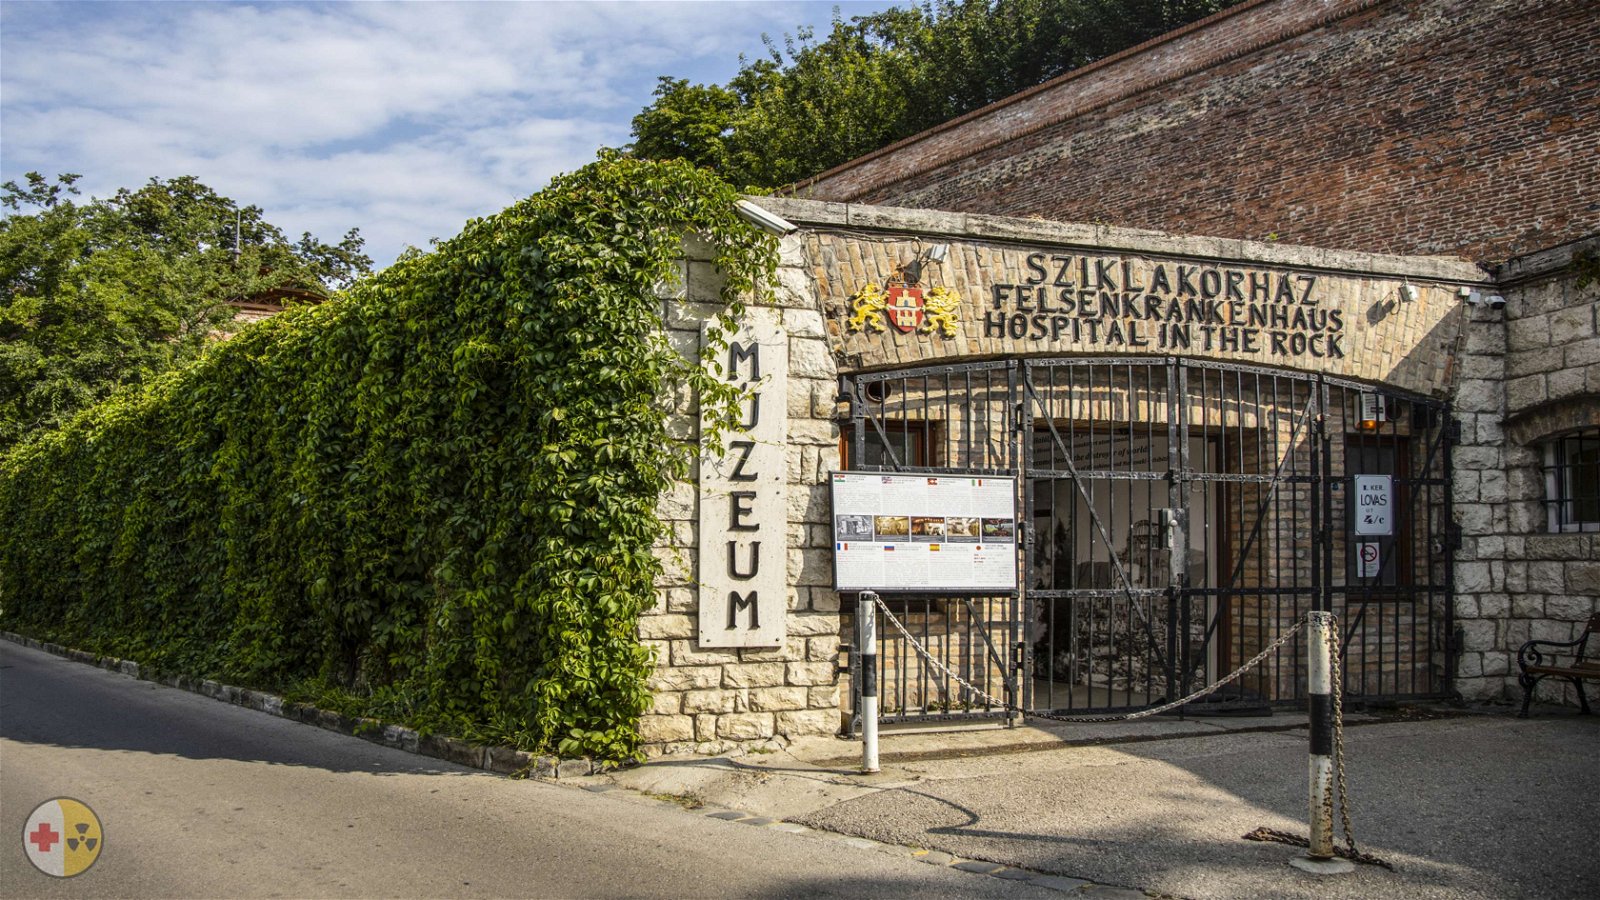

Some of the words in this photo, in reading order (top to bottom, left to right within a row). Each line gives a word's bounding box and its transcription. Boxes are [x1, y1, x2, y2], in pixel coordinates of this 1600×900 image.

[991, 283, 1344, 332] FELSENKRANKENHAUS
[984, 311, 1149, 346] HOSPITAL
[1159, 323, 1191, 349] IN
[1201, 325, 1261, 353] THE
[1271, 331, 1344, 359] ROCK
[1360, 493, 1388, 507] LOVAS
